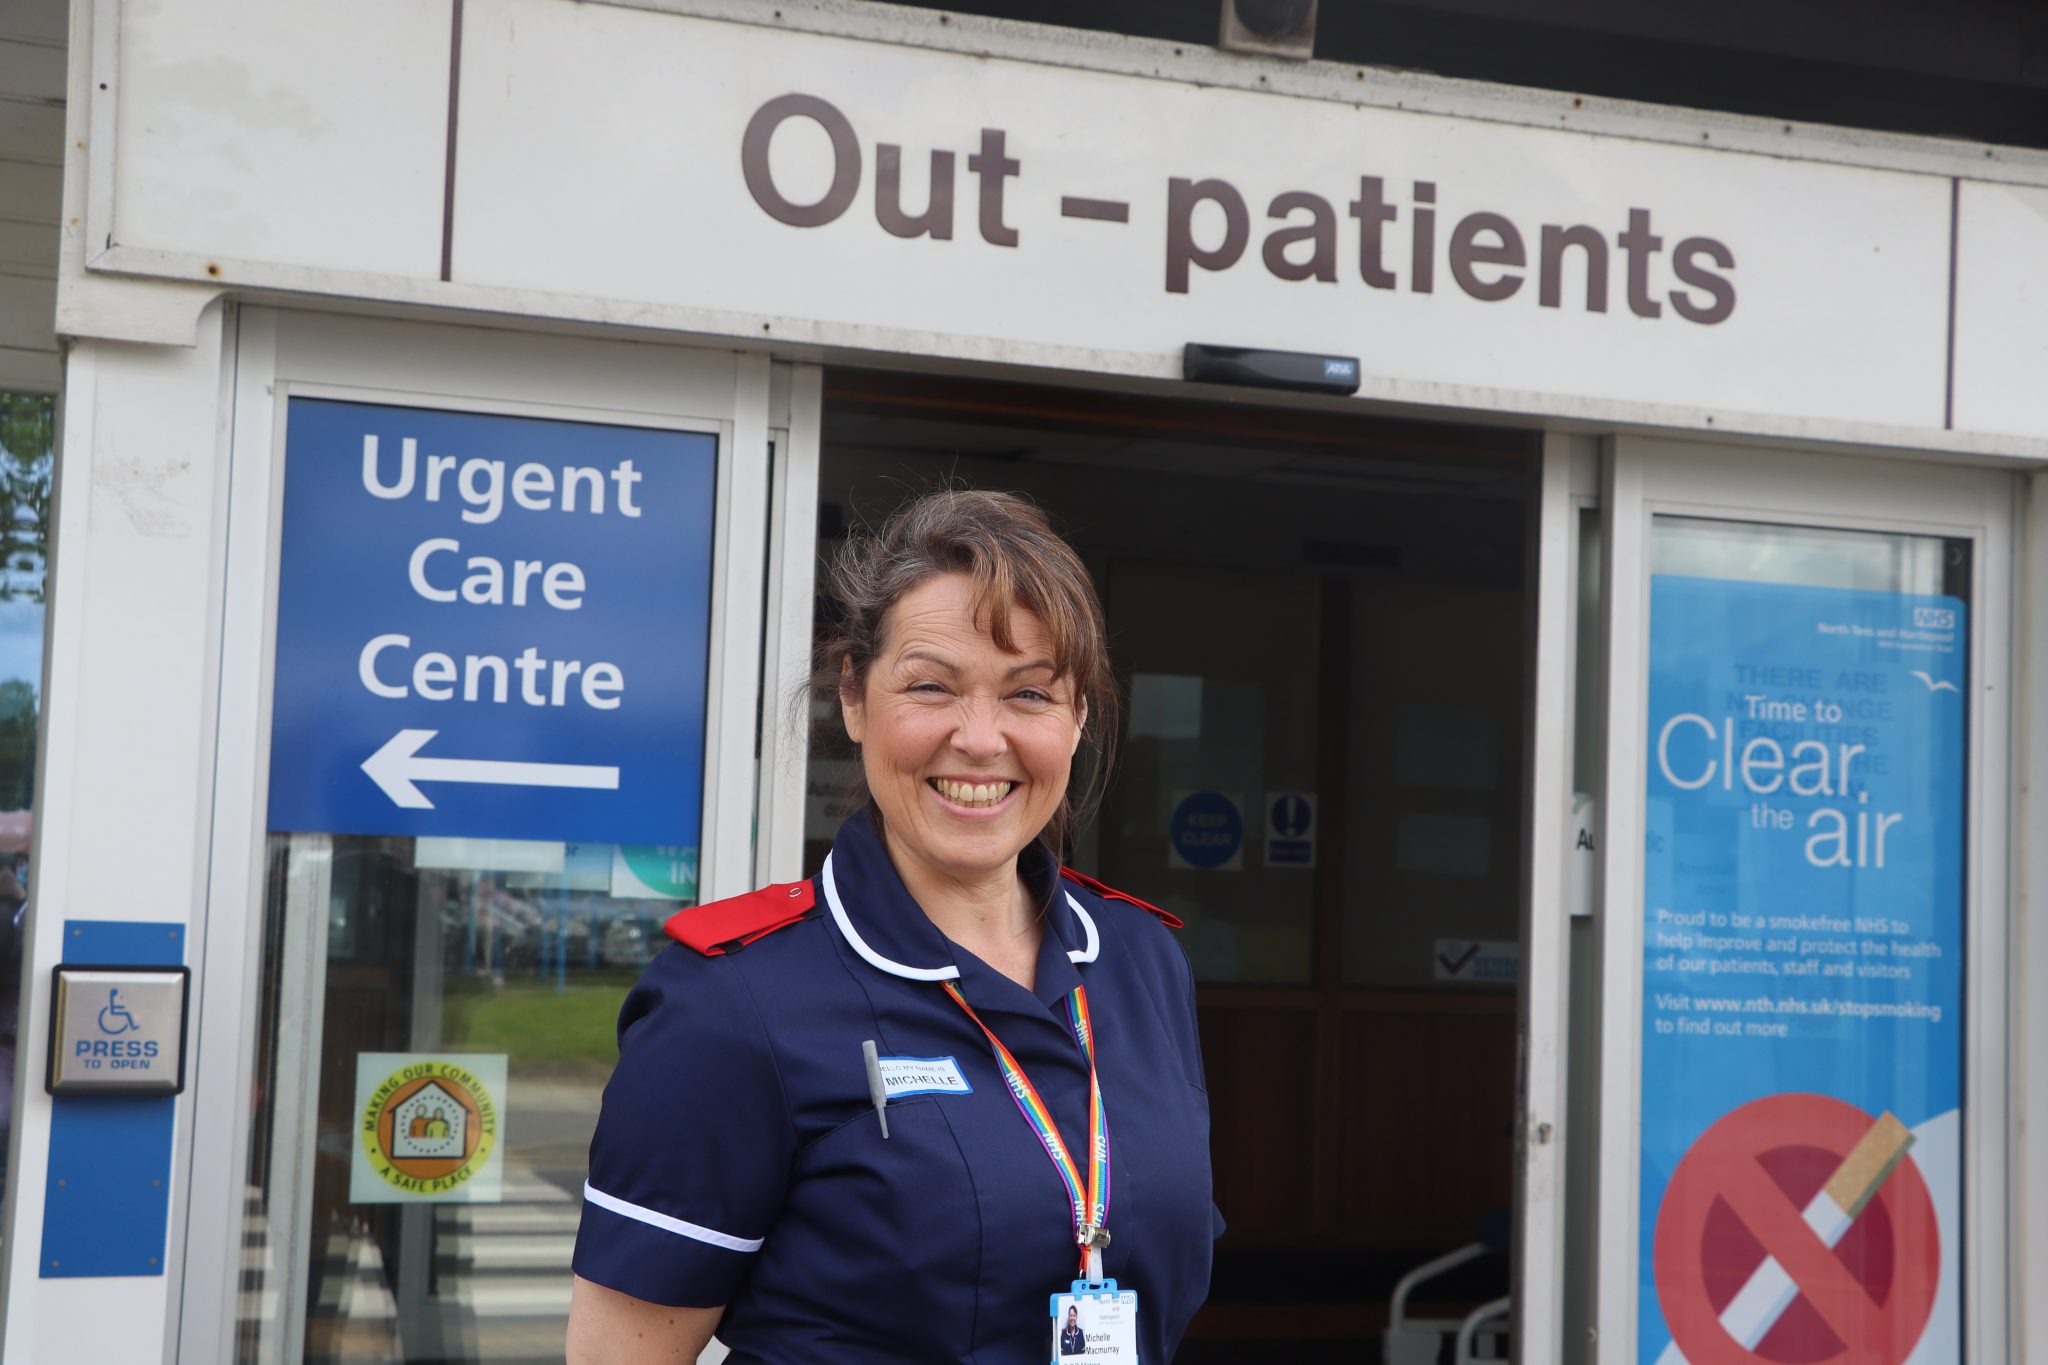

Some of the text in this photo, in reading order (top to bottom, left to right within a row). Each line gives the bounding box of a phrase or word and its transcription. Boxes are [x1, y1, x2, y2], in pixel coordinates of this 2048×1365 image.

[741, 93, 1021, 249] Out
[1164, 174, 1737, 325] patients
[361, 434, 643, 524] Urgent
[408, 538, 586, 610] Care
[1914, 608, 1954, 628] NHS
[358, 633, 625, 710] Centre
[1734, 664, 1888, 694] THERE ARE
[1744, 694, 1842, 724] Time to
[1658, 713, 1866, 796] Clear
[1188, 813, 1228, 827] KEEP
[1751, 791, 1903, 868] the air
[1182, 832, 1233, 847] CLEAR
[1656, 908, 1909, 935] Proud to be a smokefree NHS to
[1656, 931, 1942, 959] help improve and protect the health
[1656, 953, 1911, 980] of our patients, staff and visitors
[1655, 993, 1943, 1023] Visit www.nth.nhs.uk/stopsmoking
[1075, 1019, 1090, 1046] NHS
[1655, 1018, 1788, 1037] to find out more
[75, 1039, 159, 1058] PRESS
[84, 1058, 151, 1070] TO OPEN
[885, 1075, 960, 1087] MICHELLE
[1006, 1069, 1031, 1099] NHS
[365, 1064, 495, 1136] MAKING OUR COMMUNITY
[1042, 1131, 1067, 1161] NHS
[1093, 1132, 1107, 1163] NHS
[379, 1165, 475, 1193] A SAFE PLACE
[1074, 1200, 1087, 1227] NH
[1092, 1201, 1105, 1227] HS
[1085, 1333, 1111, 1343] Michelle
[1085, 1345, 1120, 1356] Macmurray
